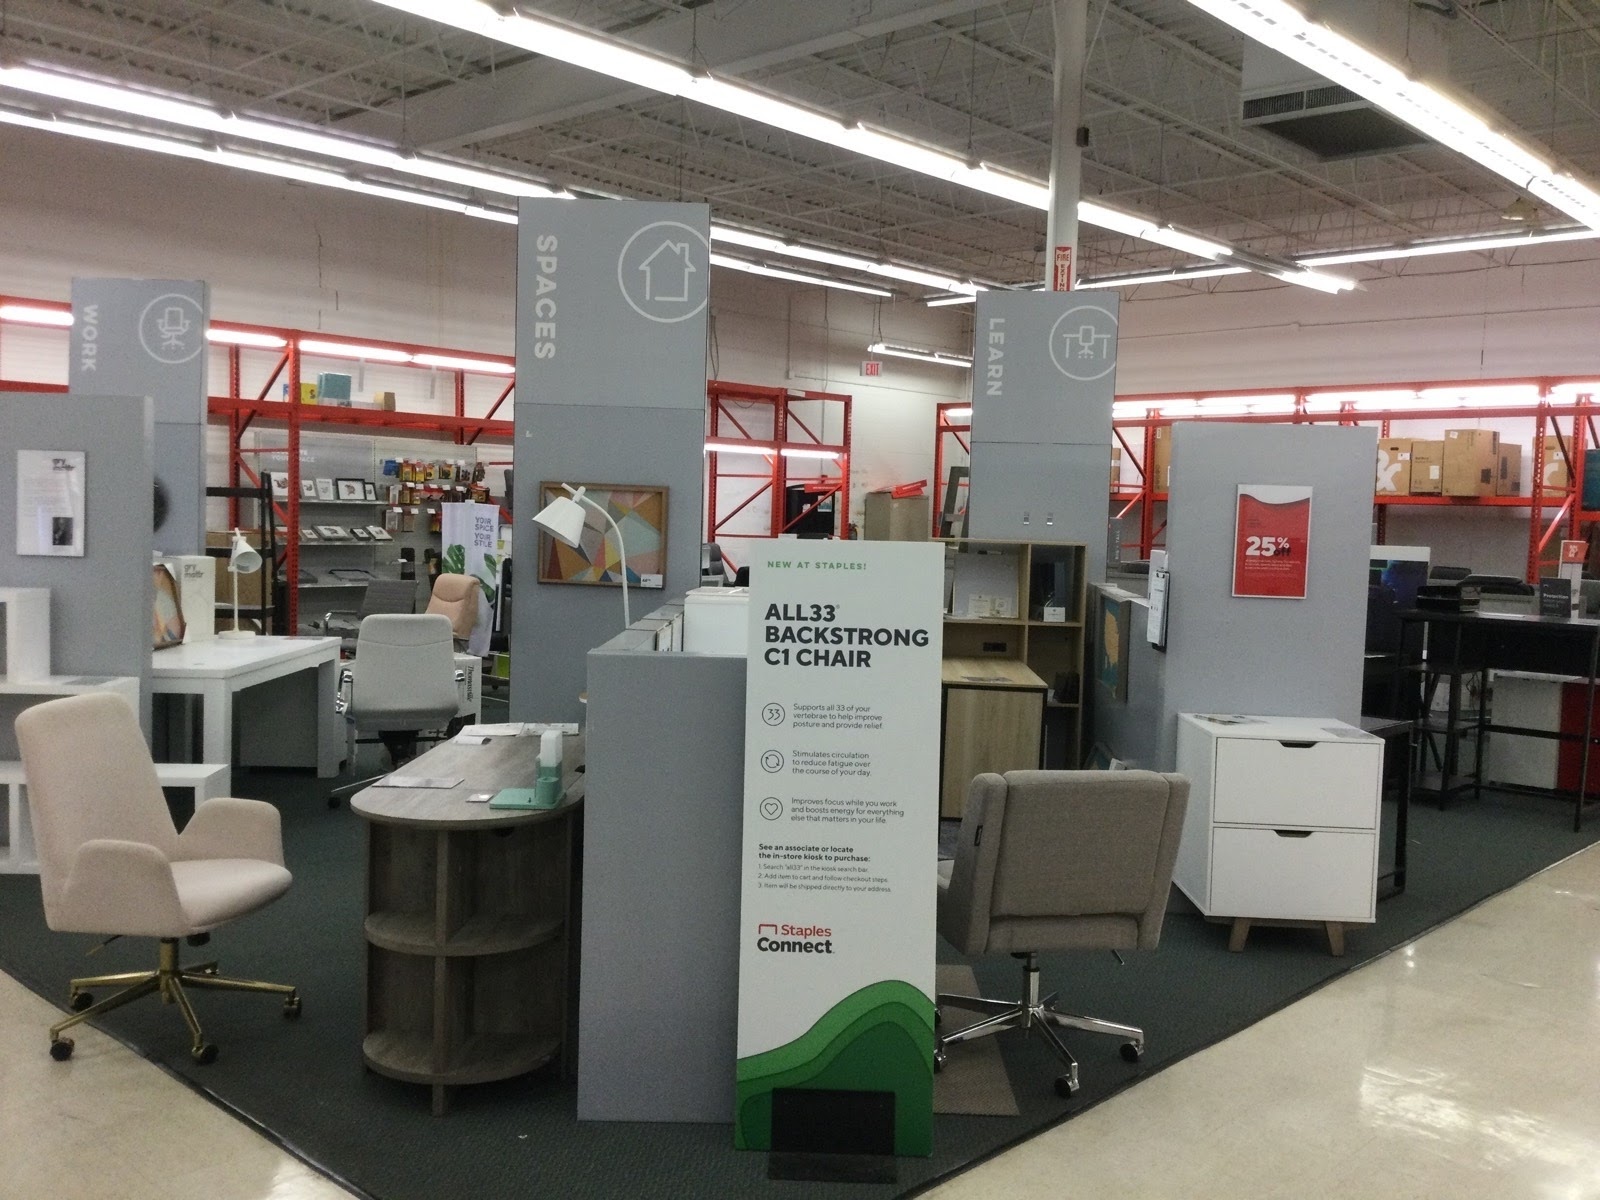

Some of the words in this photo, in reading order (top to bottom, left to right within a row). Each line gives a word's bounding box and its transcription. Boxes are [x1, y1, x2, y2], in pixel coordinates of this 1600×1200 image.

[1057, 253, 1070, 261] FIRE
[534, 234, 558, 359] SPACES
[81, 304, 99, 372] WORK
[986, 317, 1005, 396] LEARN
[865, 362, 880, 376] EXIT
[474, 532, 491, 541] YOR
[1245, 536, 1290, 557] 25%
[1274, 547, 1292, 556] off
[767, 561, 792, 569] NEW
[815, 562, 867, 570] STAPLES!
[765, 625, 929, 647] BACKSTRONG
[764, 648, 790, 666] C1
[796, 649, 871, 668] CHAIR
[794, 703, 825, 712] Supports
[794, 712, 828, 720] vertebrae
[838, 713, 853, 721] help
[855, 714, 882, 722] improve
[793, 721, 820, 729] posture
[793, 750, 830, 758] Stimulates
[832, 751, 869, 759] circulation
[828, 760, 853, 768] fatigue
[857, 769, 872, 777] day.
[792, 798, 824, 806] Improves
[825, 798, 844, 806] focus
[846, 799, 864, 807] while
[806, 806, 829, 814] boosts
[867, 809, 904, 817] everything
[785, 845, 819, 853] associate
[804, 853, 823, 861] kiosk
[834, 855, 871, 863] purchase:
[781, 924, 832, 939] Staples
[757, 937, 833, 954] Connect
